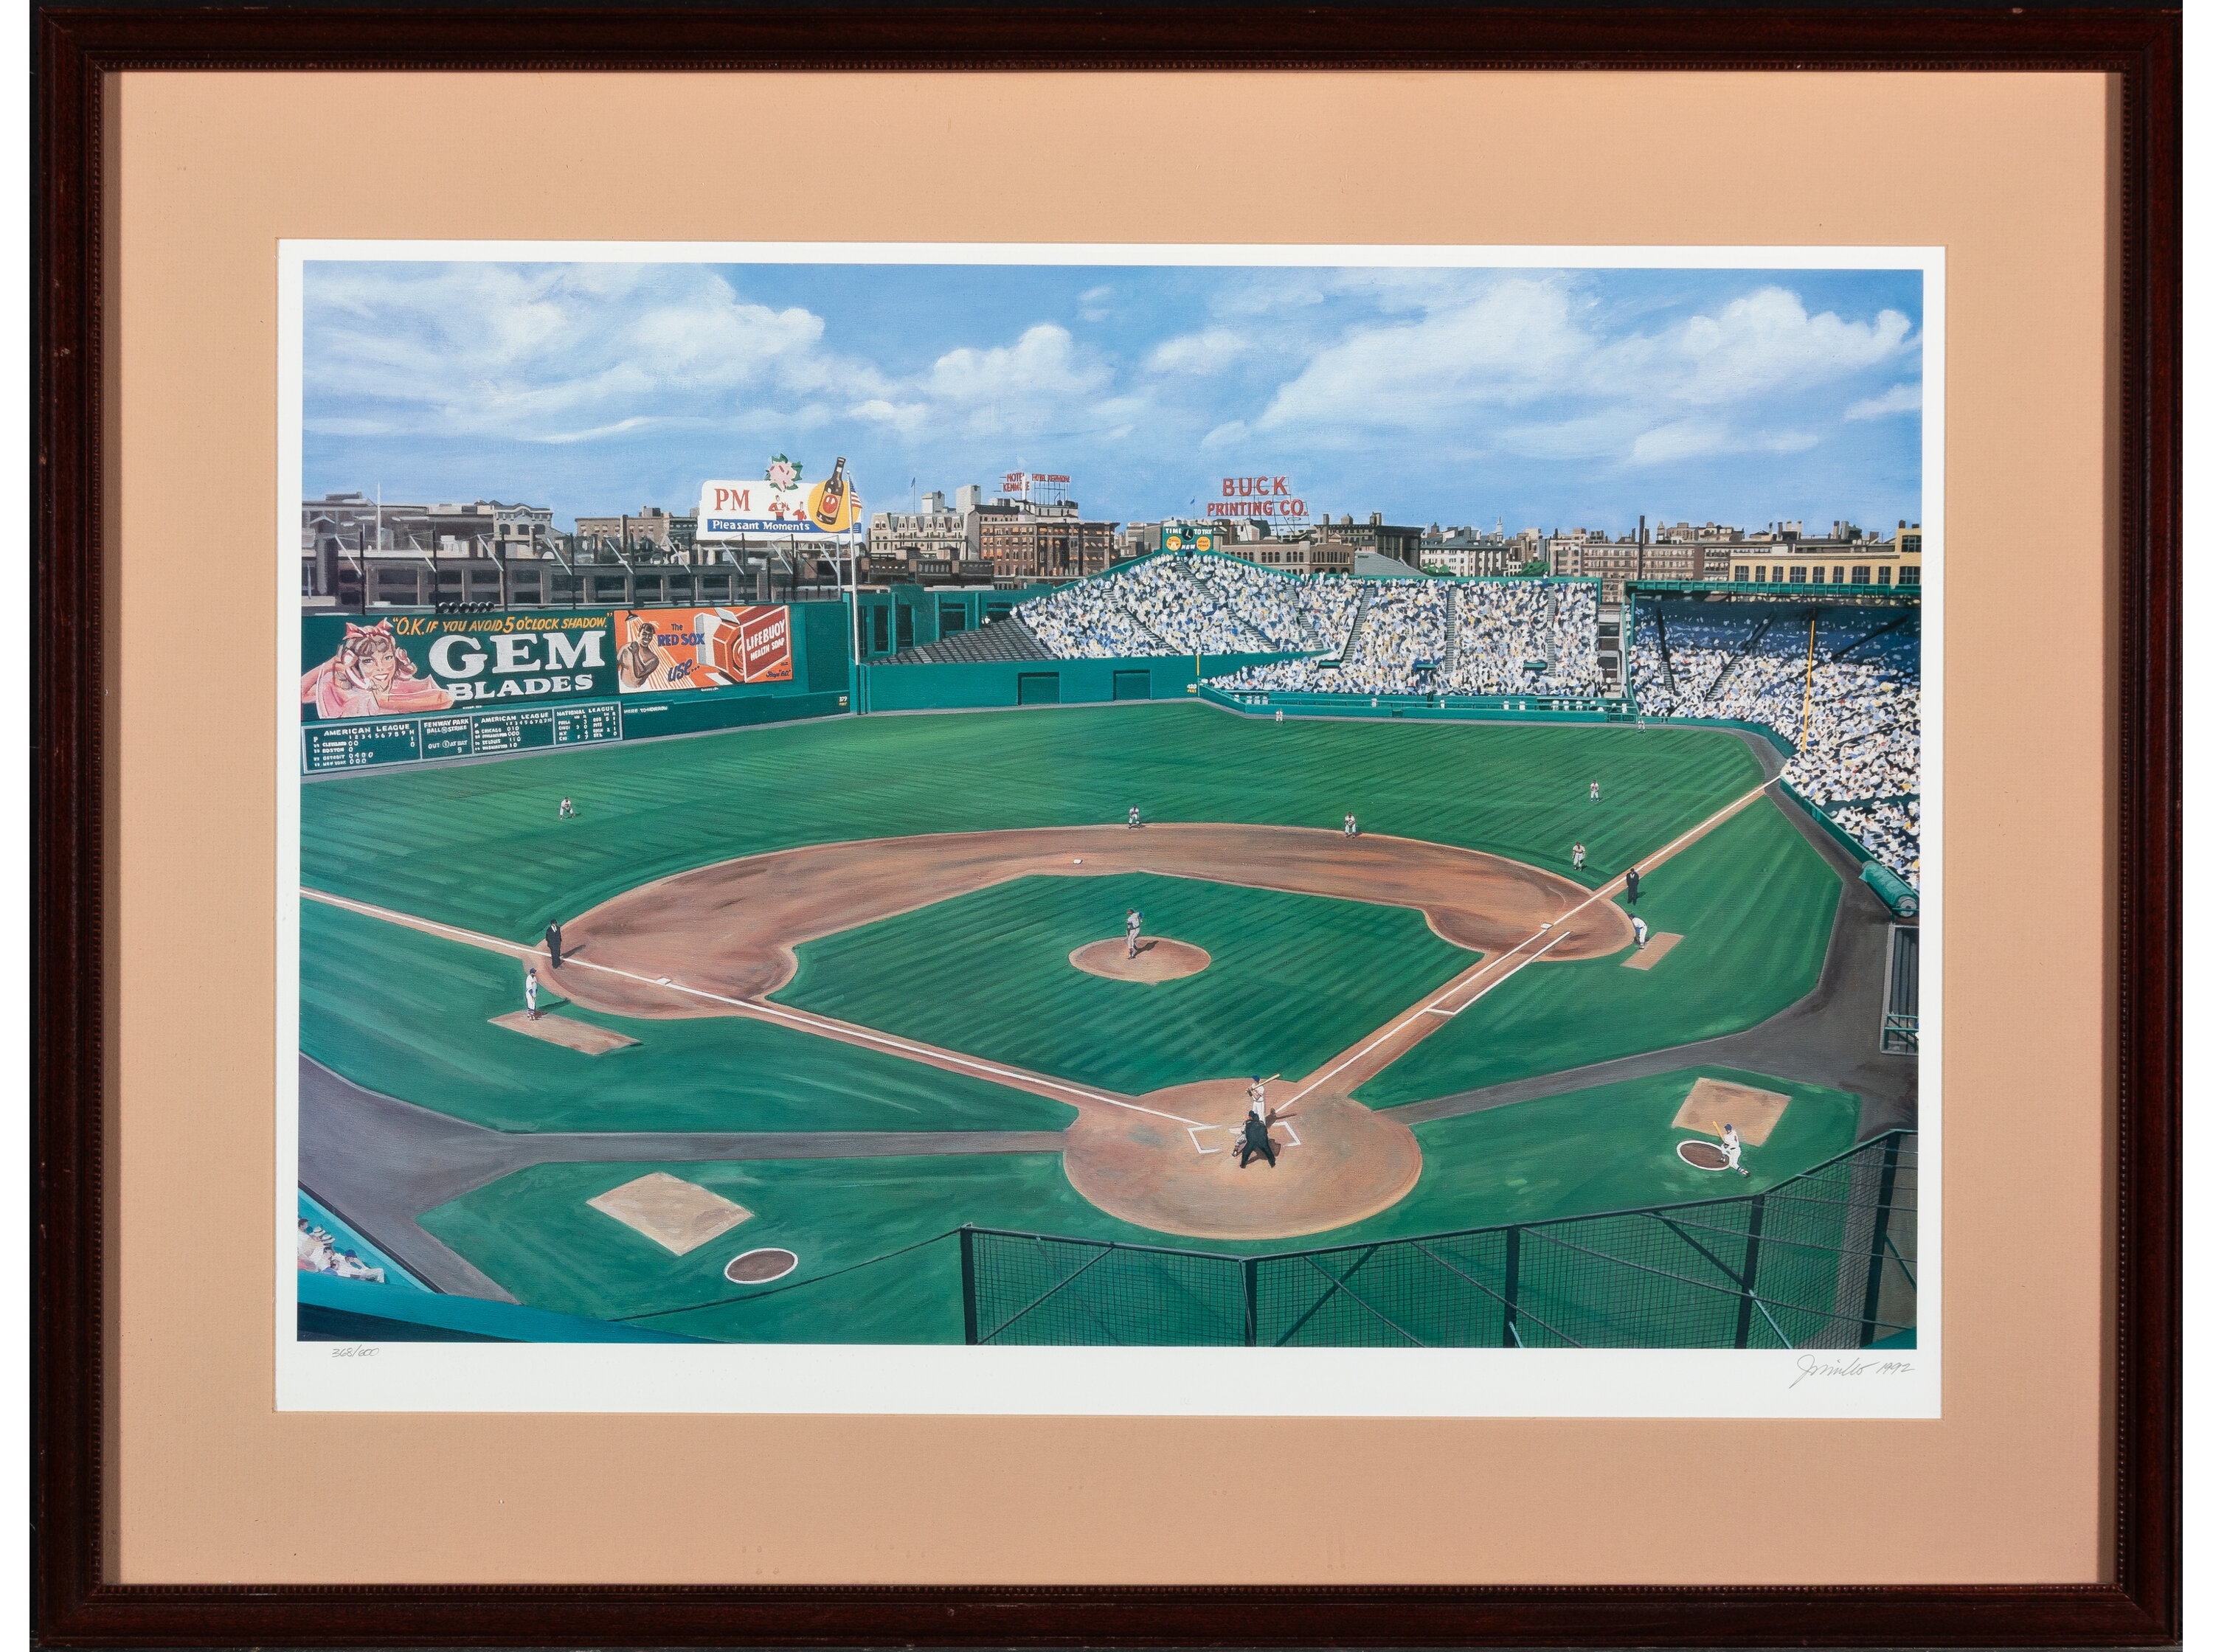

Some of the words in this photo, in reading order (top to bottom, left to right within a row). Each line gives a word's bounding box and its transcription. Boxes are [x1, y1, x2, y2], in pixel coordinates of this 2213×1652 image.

[1223, 476, 1287, 496] BUCK
[714, 488, 750, 511] PM
[1207, 501, 1272, 516] PRINTING
[1280, 499, 1307, 516] CO.
[713, 520, 758, 530] Pleasant
[763, 522, 810, 530] Moments
[426, 621, 439, 633] IF
[443, 621, 467, 632] YOU
[468, 620, 503, 632] AVOID
[503, 617, 516, 634] 5
[657, 634, 679, 647] RED
[681, 633, 705, 646] SOX
[746, 619, 785, 651] LIFEBUOY
[429, 631, 606, 679] GEM
[750, 644, 770, 661] HEALTH
[771, 637, 785, 650] SOAP
[446, 674, 593, 701] BLADES
[423, 720, 451, 728] FENWAY
[521, 712, 549, 720] LEAGUE
[324, 726, 371, 736] AMERICAN
[376, 723, 410, 732] LEAGUE
[332, 1344, 380, 1358] 368/600
